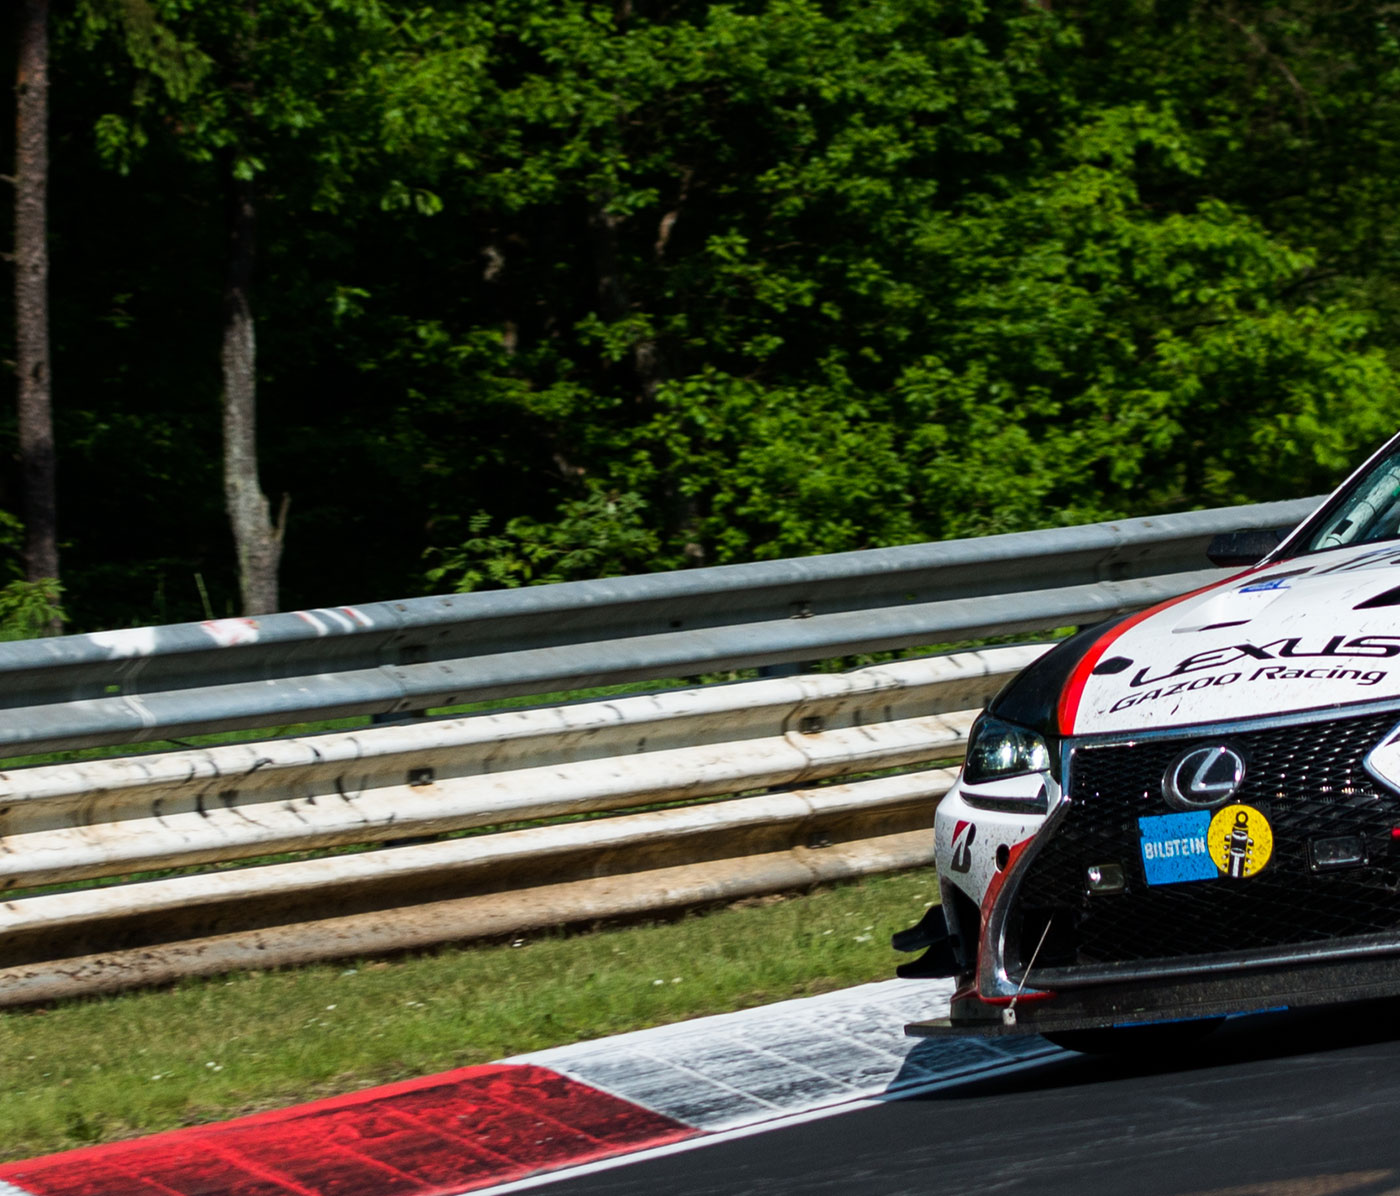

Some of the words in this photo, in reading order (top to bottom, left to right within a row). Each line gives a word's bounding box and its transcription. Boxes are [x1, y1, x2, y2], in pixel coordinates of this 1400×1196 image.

[1109, 671, 1243, 714] GAZOO
[1247, 663, 1389, 686] Racing
[1144, 836, 1206, 861] BILSTEIN
